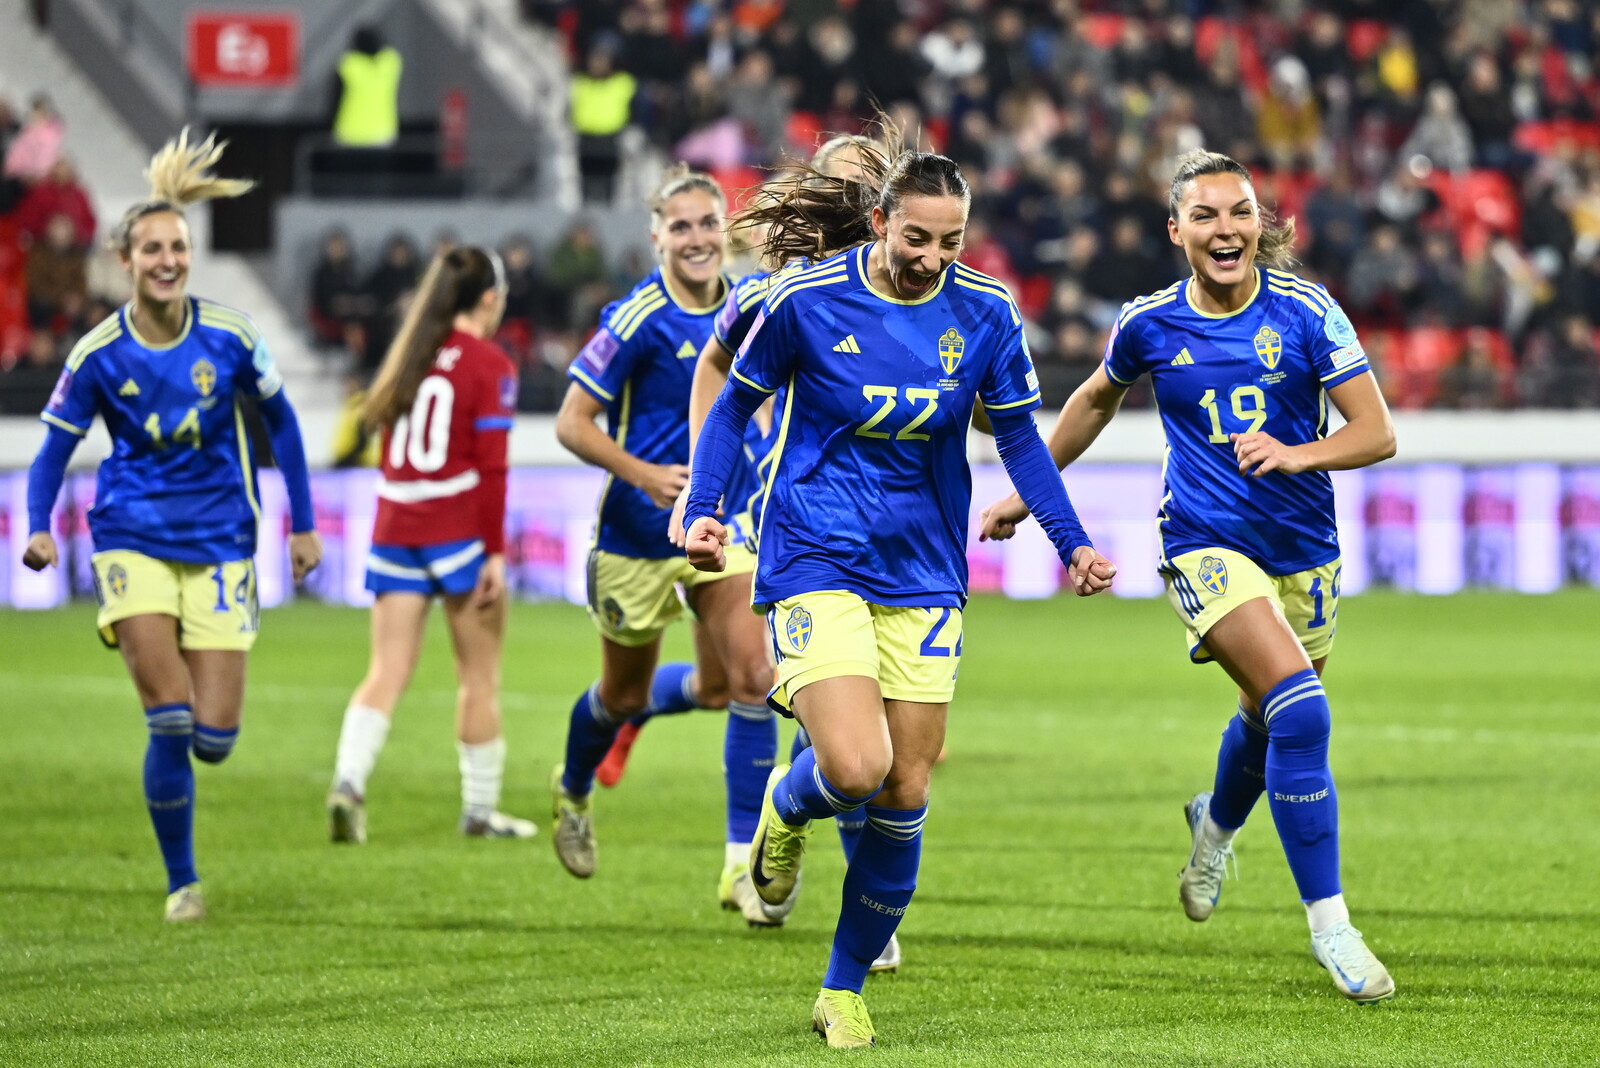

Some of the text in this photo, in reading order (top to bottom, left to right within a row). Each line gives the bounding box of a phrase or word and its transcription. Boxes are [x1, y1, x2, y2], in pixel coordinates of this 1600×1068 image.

[144, 407, 201, 450] 14
[390, 375, 454, 473] 10
[855, 385, 939, 441] 22
[1199, 385, 1267, 443] 19
